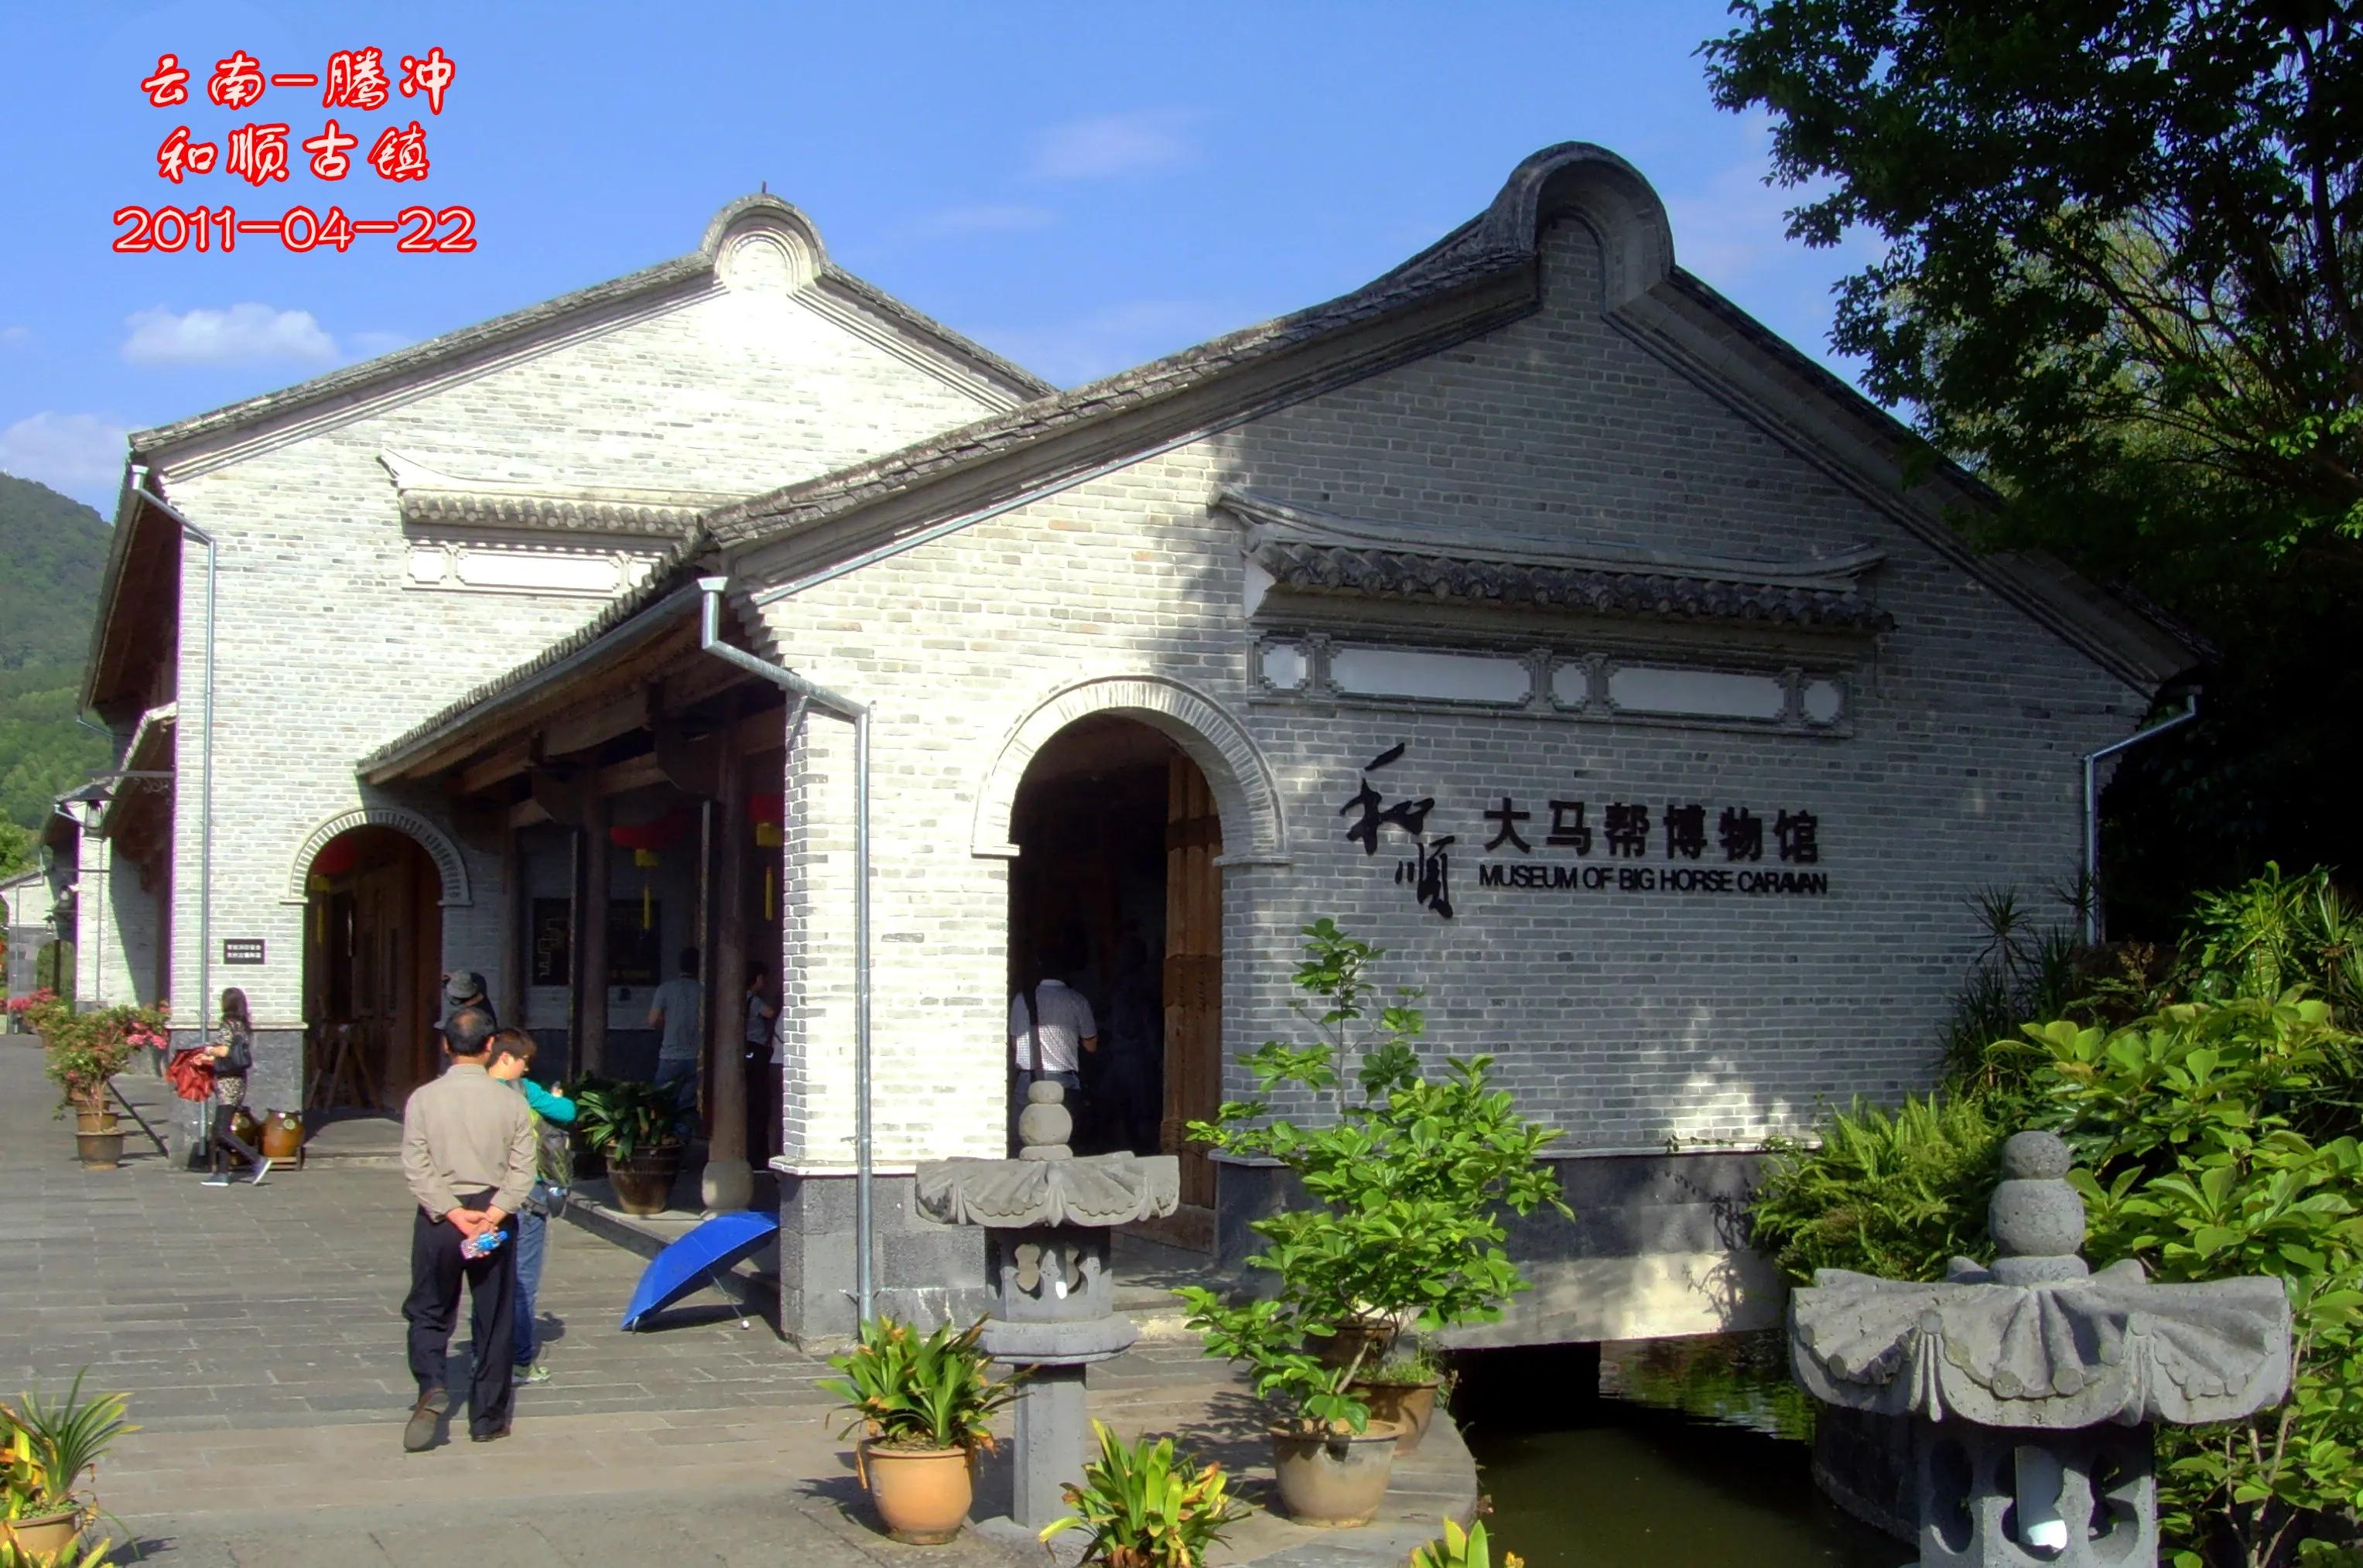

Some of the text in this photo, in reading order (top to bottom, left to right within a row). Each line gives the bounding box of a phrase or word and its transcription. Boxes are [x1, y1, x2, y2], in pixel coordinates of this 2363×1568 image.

[1483, 797, 1820, 863] 大马帮博物馆
[1479, 863, 1828, 895] MUSEUM OF BIG HORSE CARAVAN
